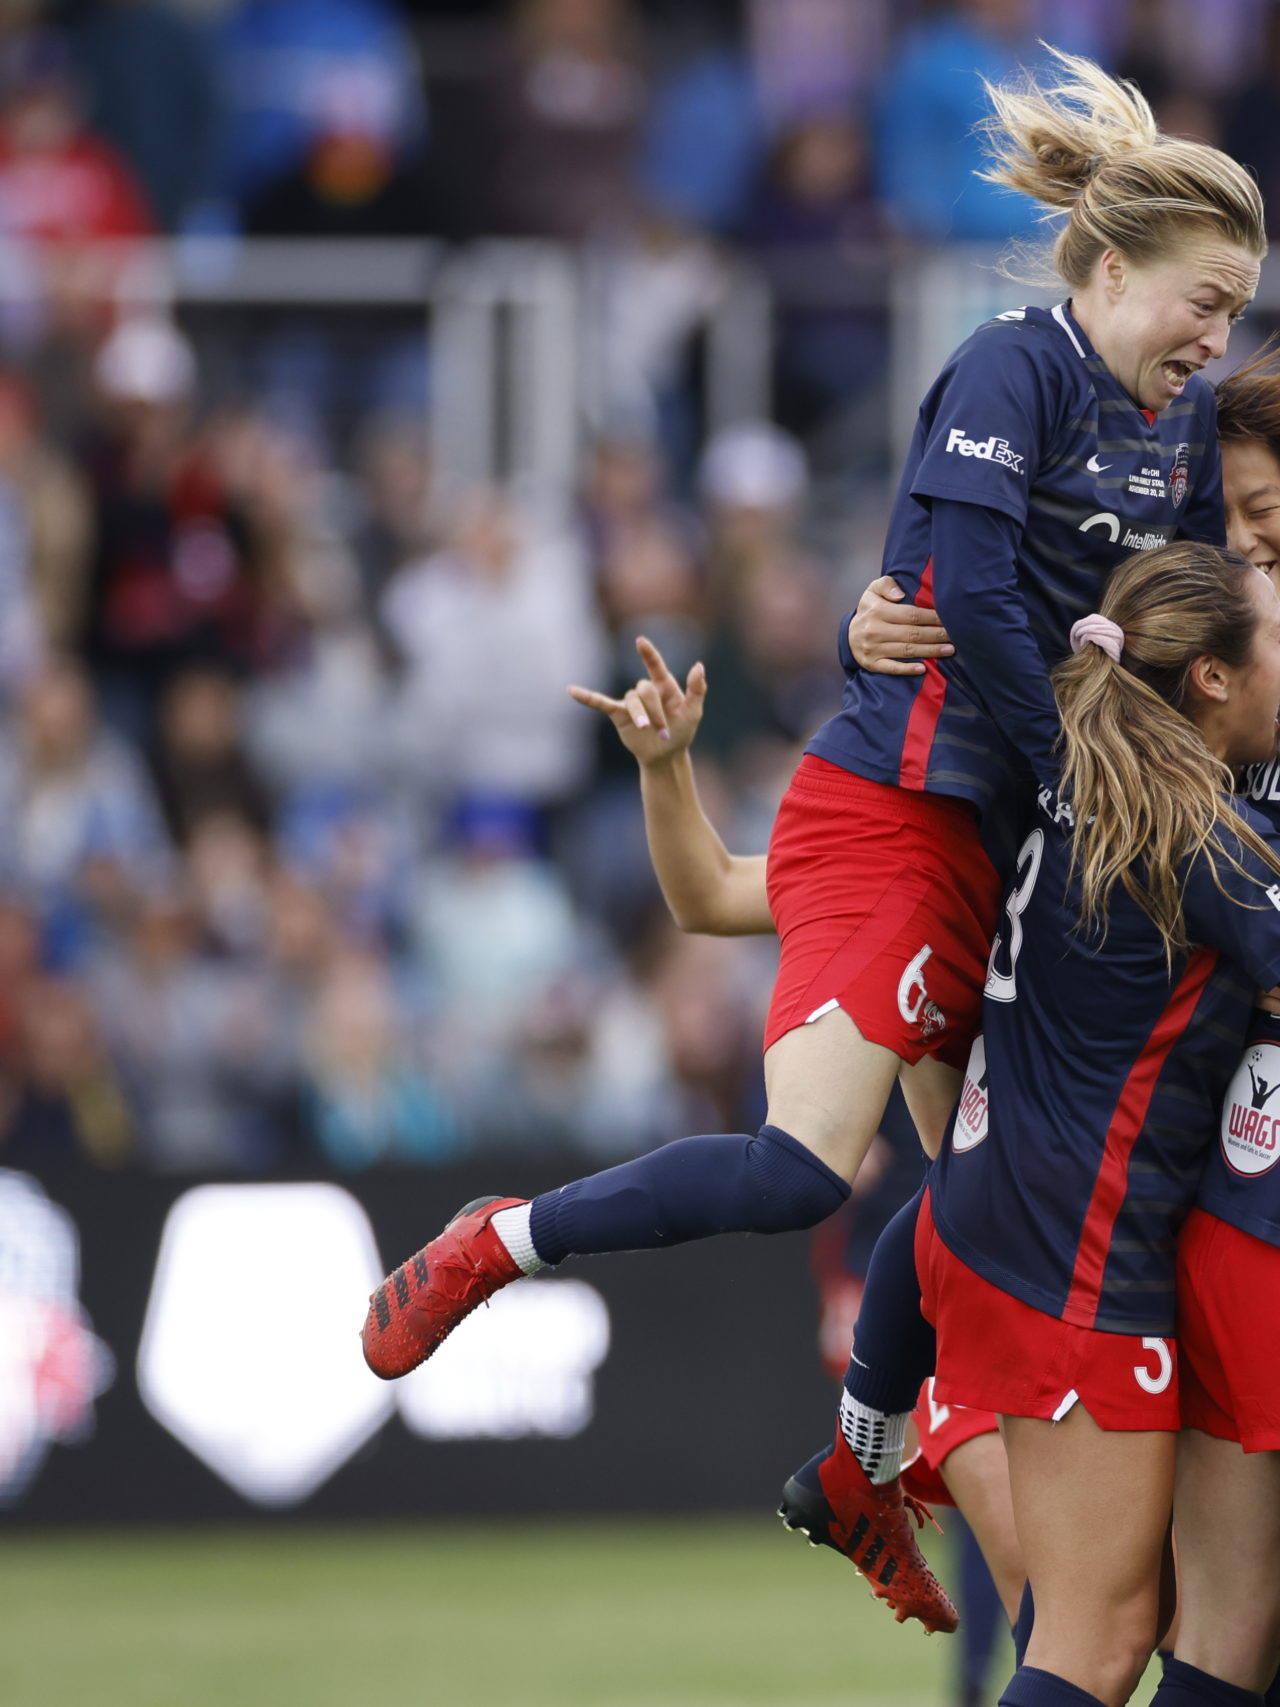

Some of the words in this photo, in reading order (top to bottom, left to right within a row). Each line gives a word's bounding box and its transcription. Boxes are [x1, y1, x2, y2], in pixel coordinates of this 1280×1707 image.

[946, 428, 1024, 473] FedEx
[897, 944, 933, 1024] 6
[1133, 1336, 1173, 1395] 3
